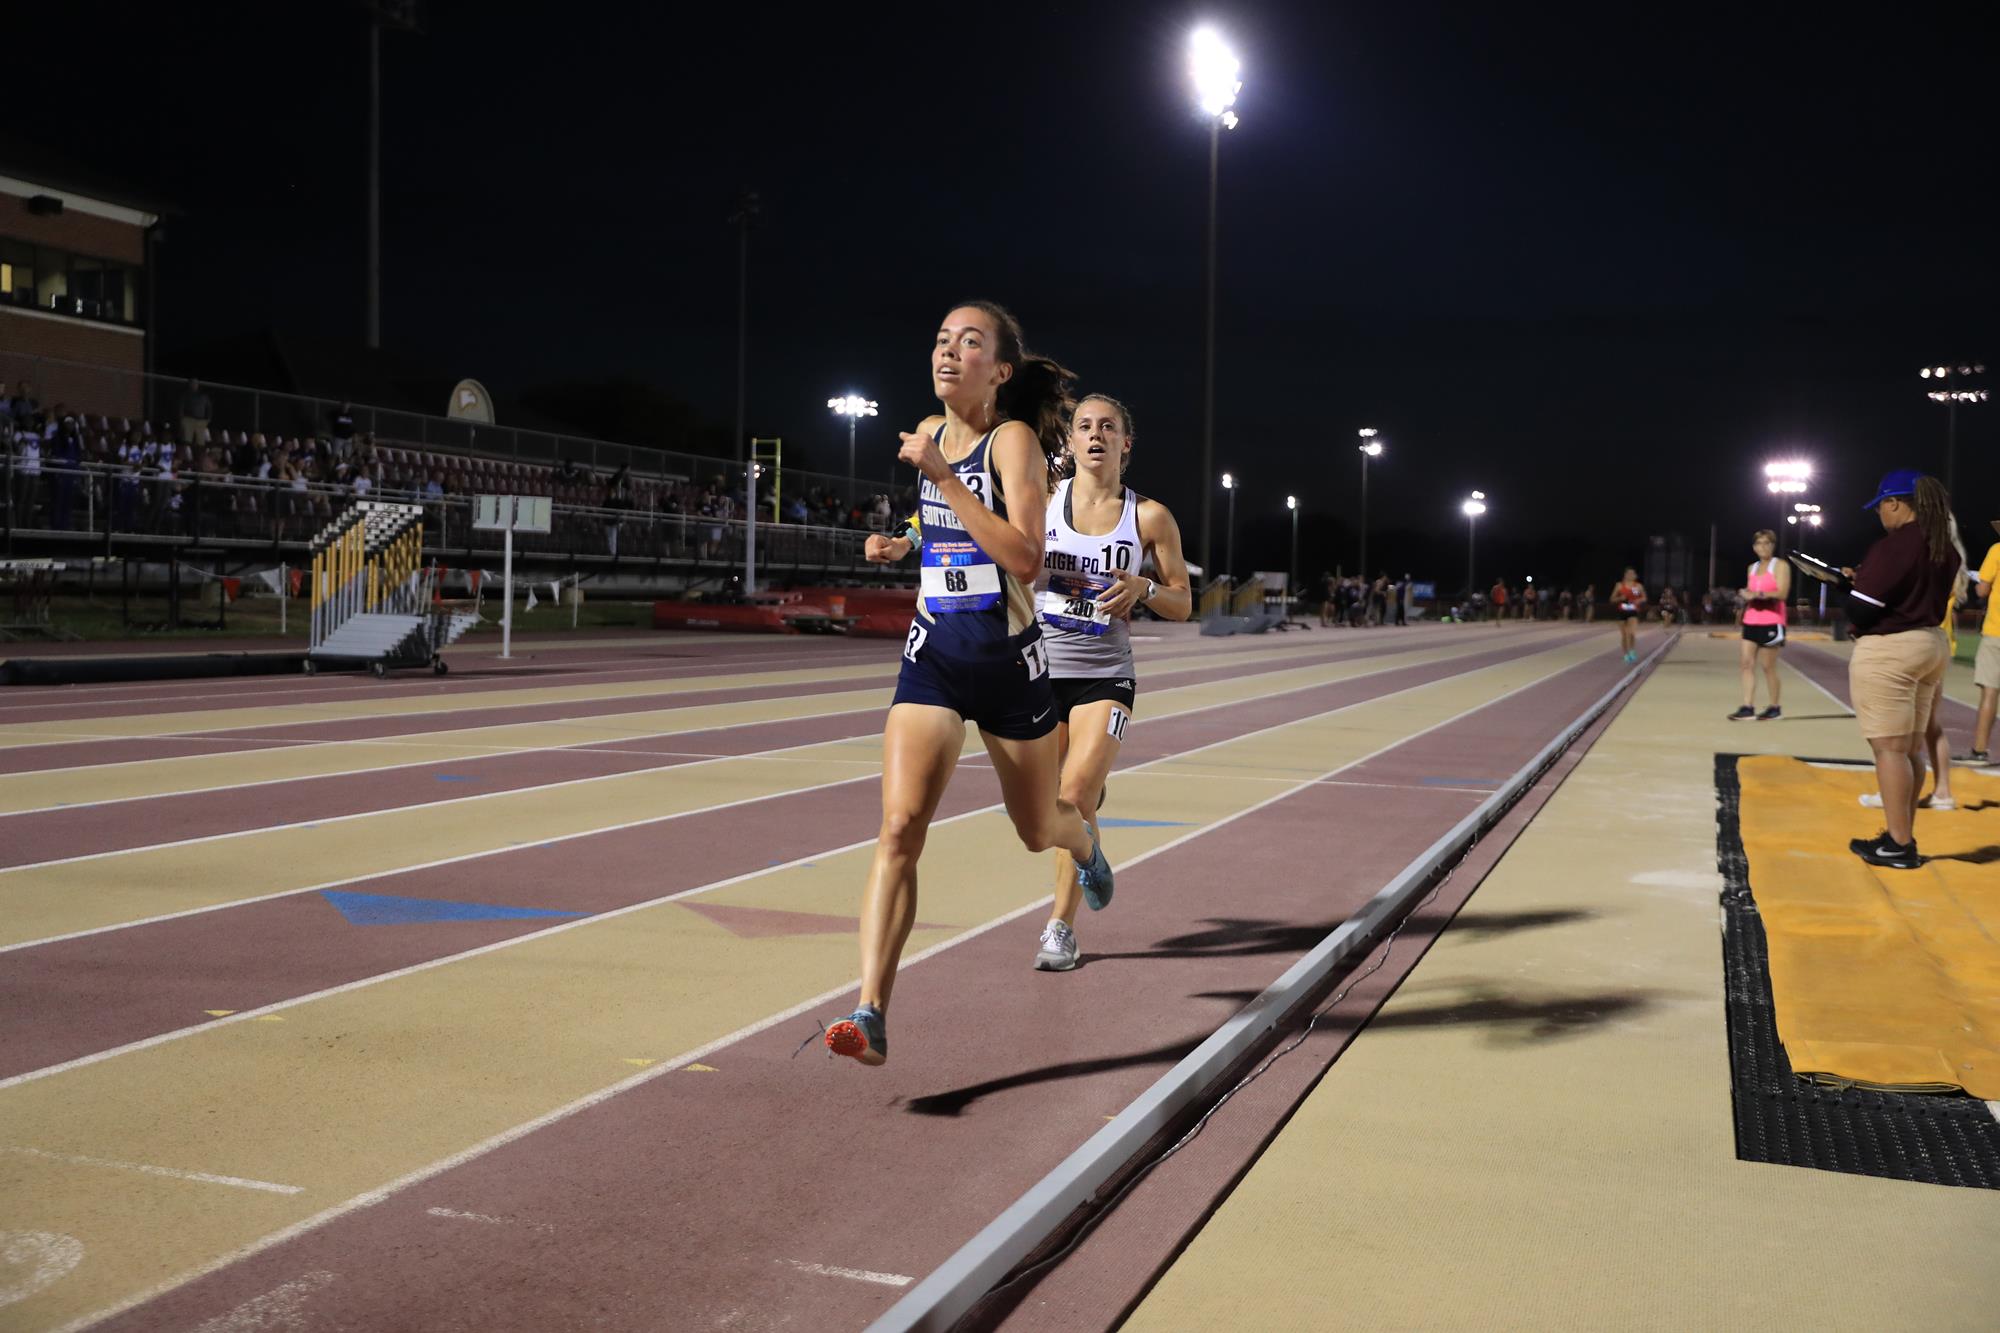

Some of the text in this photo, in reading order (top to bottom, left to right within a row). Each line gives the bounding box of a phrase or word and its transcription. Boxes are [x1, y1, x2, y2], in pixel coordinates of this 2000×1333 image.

[1044, 551, 1077, 572] HIGH
[1101, 545, 1130, 572] 10
[944, 569, 968, 592] 68
[1112, 710, 1129, 741] 10
